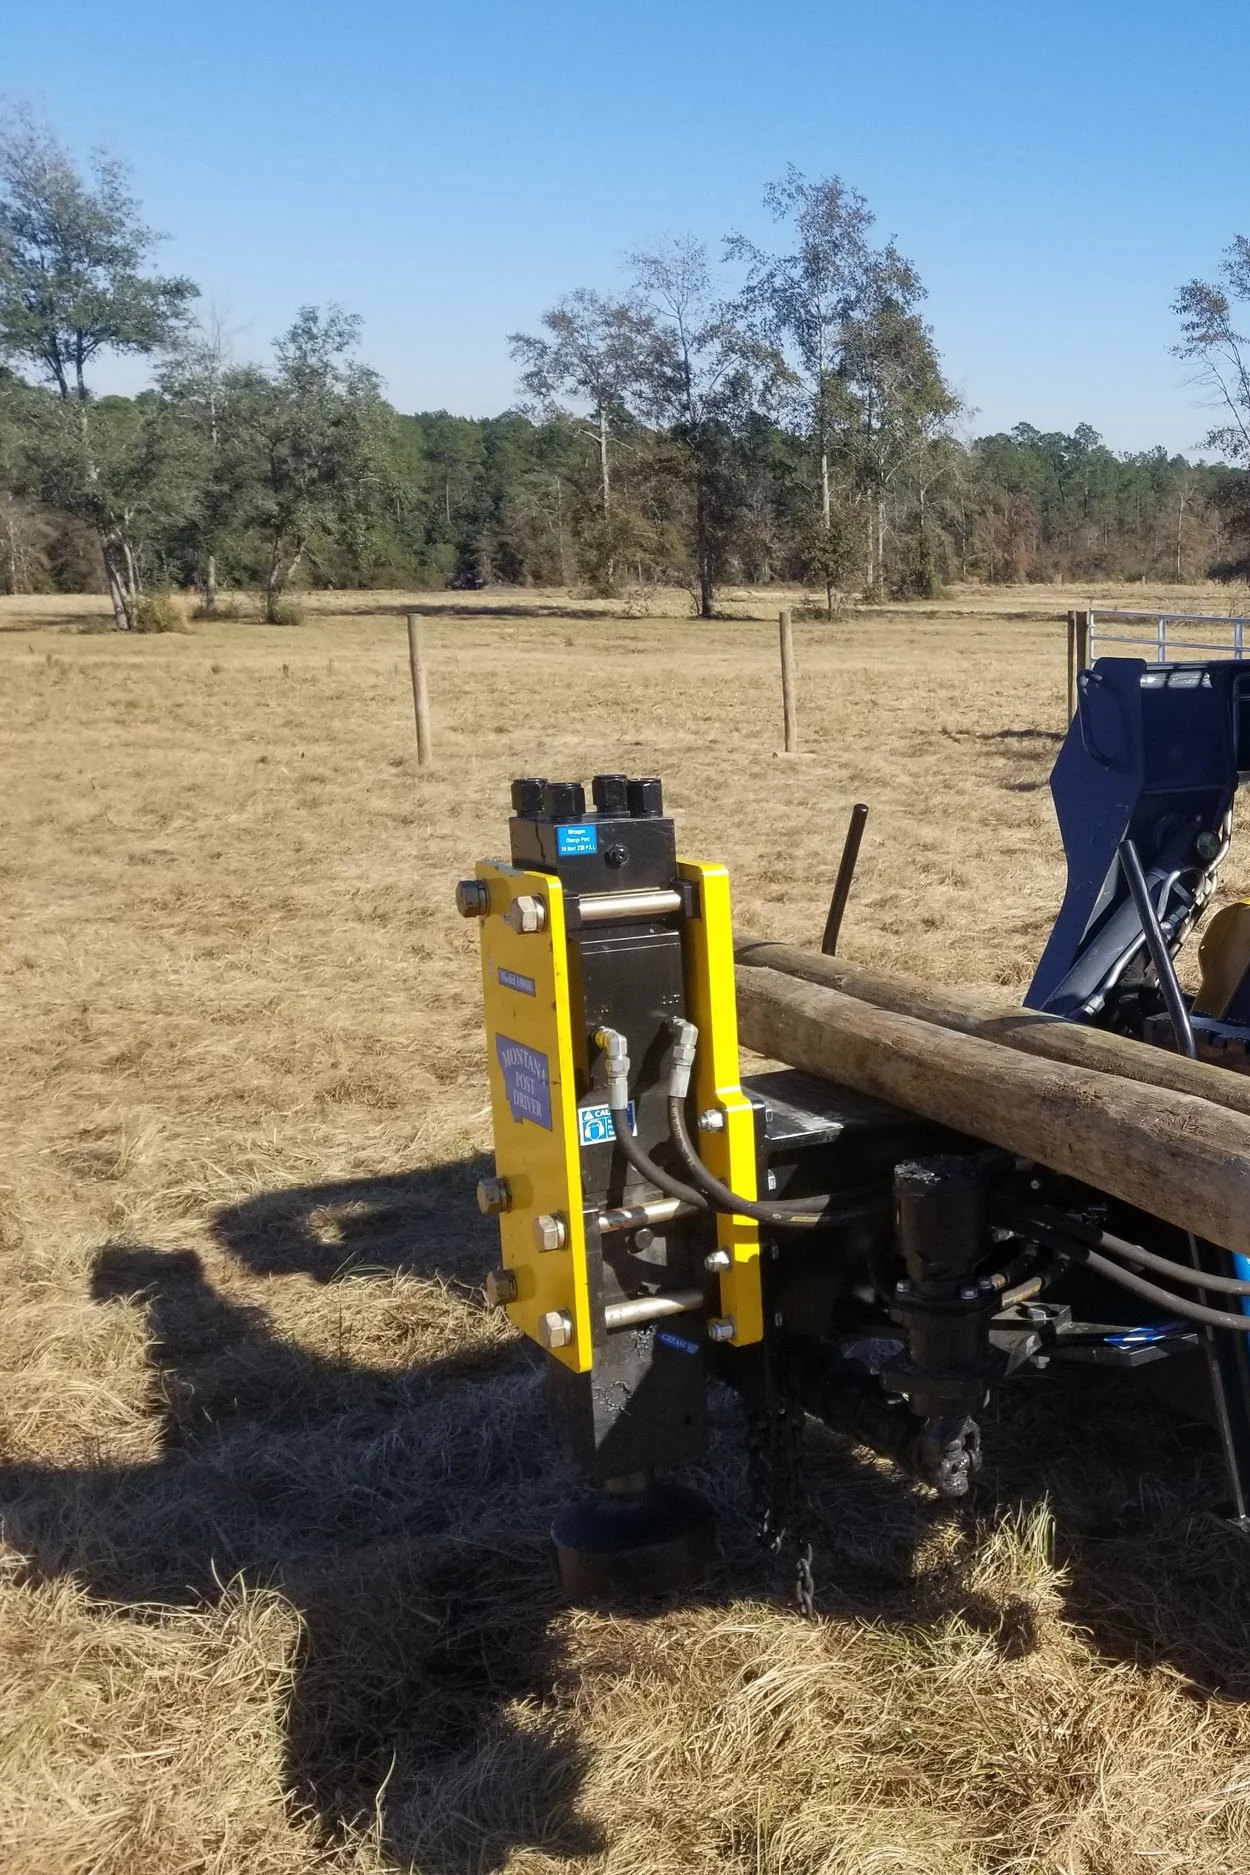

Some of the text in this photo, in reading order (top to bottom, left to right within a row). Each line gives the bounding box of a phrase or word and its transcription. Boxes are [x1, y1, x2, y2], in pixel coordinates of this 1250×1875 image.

[502, 1047, 547, 1088] MONTANA
[515, 1071, 535, 1094] POST
[513, 1089, 543, 1118] DRIVER
